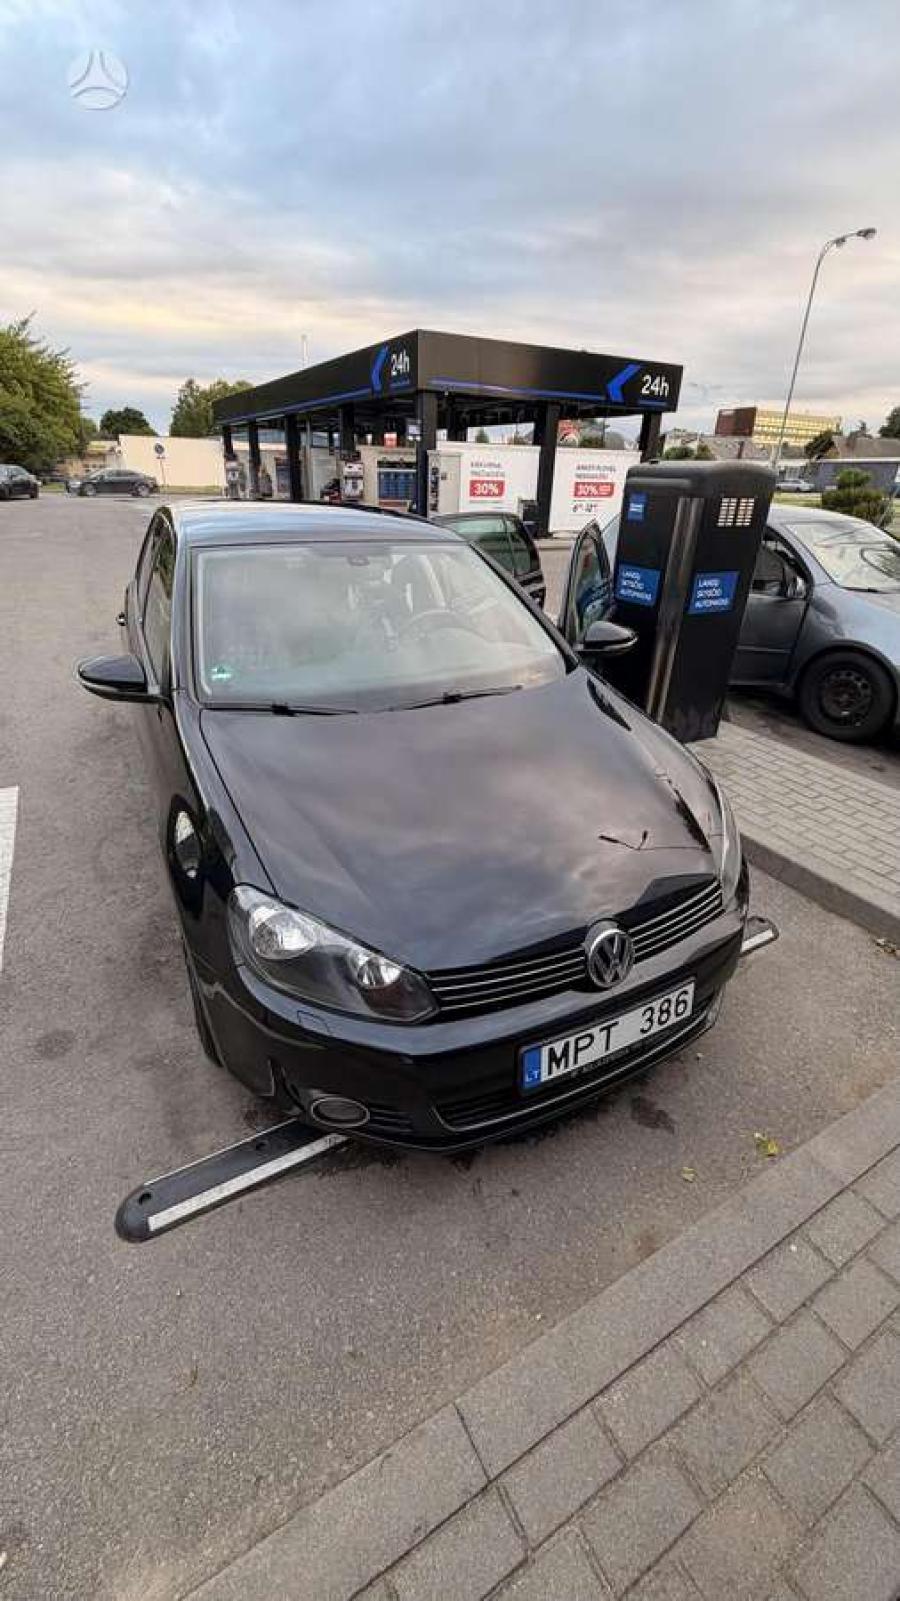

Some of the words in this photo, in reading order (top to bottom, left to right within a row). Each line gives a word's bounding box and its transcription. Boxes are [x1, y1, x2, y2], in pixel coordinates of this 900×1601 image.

[391, 350, 410, 376] 24h
[641, 374, 670, 396] 24h
[472, 483, 499, 497] 30%
[547, 1021, 619, 1076] MPT
[640, 990, 690, 1034] 386
